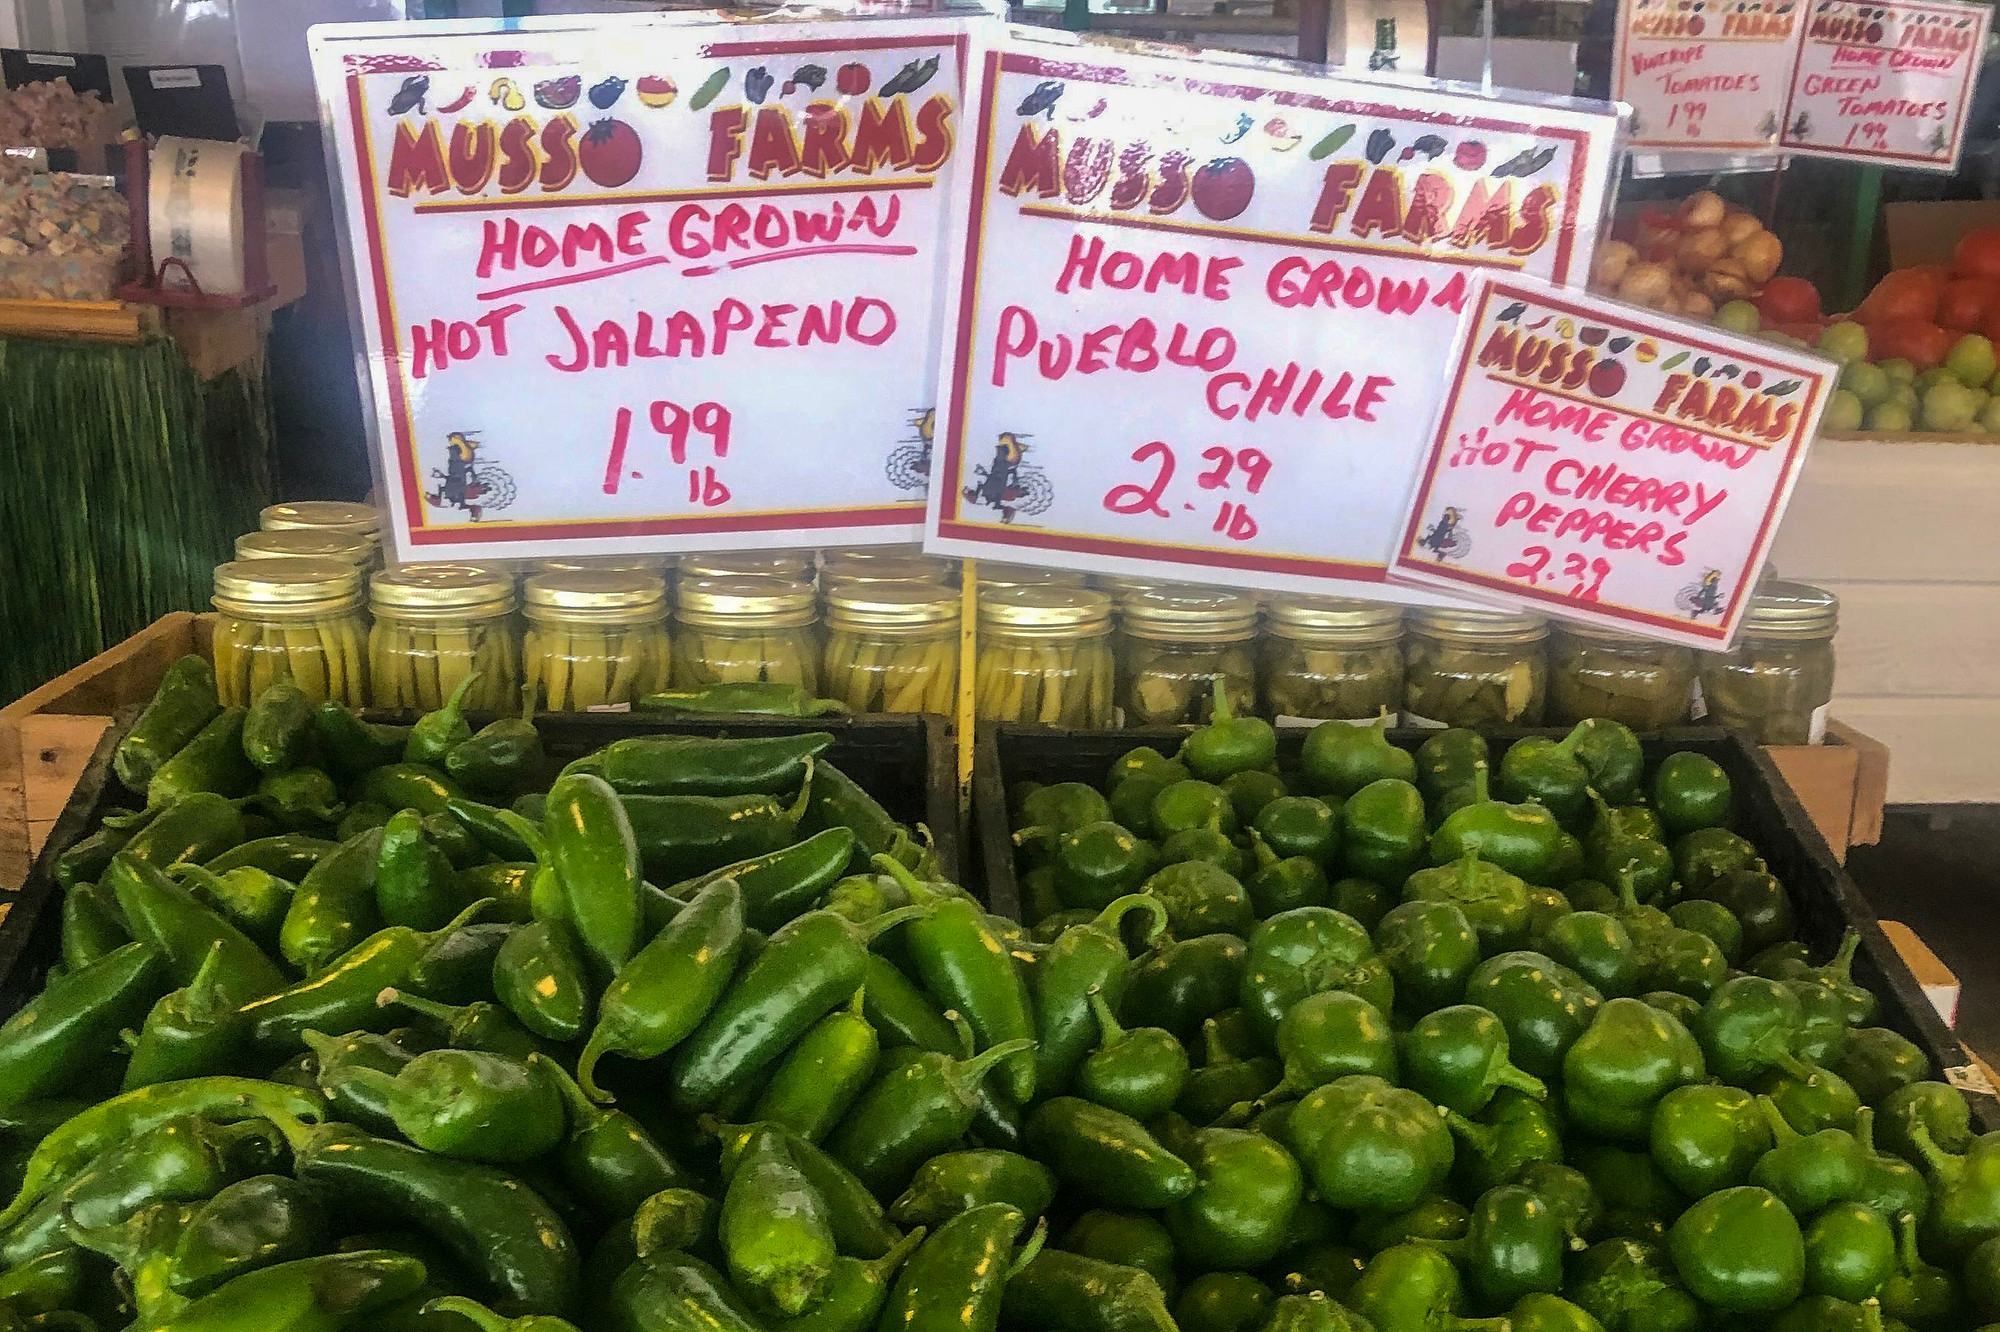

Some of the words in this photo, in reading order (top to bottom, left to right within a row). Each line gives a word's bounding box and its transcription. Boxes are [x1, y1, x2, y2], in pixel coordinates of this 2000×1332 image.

[1656, 68, 1760, 95] TOMATOES
[1803, 73, 1881, 96] GREEN
[1838, 96, 1947, 121] TOMATOES
[705, 94, 955, 183] FARMS
[476, 210, 650, 278] HOME
[669, 194, 900, 259] GROWN
[1310, 159, 1561, 256] FARMS
[1055, 234, 1243, 300] HOME
[411, 304, 526, 379] HOT
[546, 297, 896, 373] JALAPENO
[992, 304, 1240, 387] PUEBLO
[1206, 361, 1397, 423] CHILE
[1494, 388, 1618, 443] HOME
[1620, 419, 1758, 470] GROWN
[1653, 372, 1798, 442] FARMS
[602, 401, 732, 495] 1.99
[1102, 441, 1273, 519] 2.29
[1450, 426, 1558, 473] HOT
[1545, 458, 1729, 526] CHERRY
[689, 467, 731, 507] lb
[1213, 502, 1258, 541] lb
[1494, 491, 1689, 566] PEPPERS
